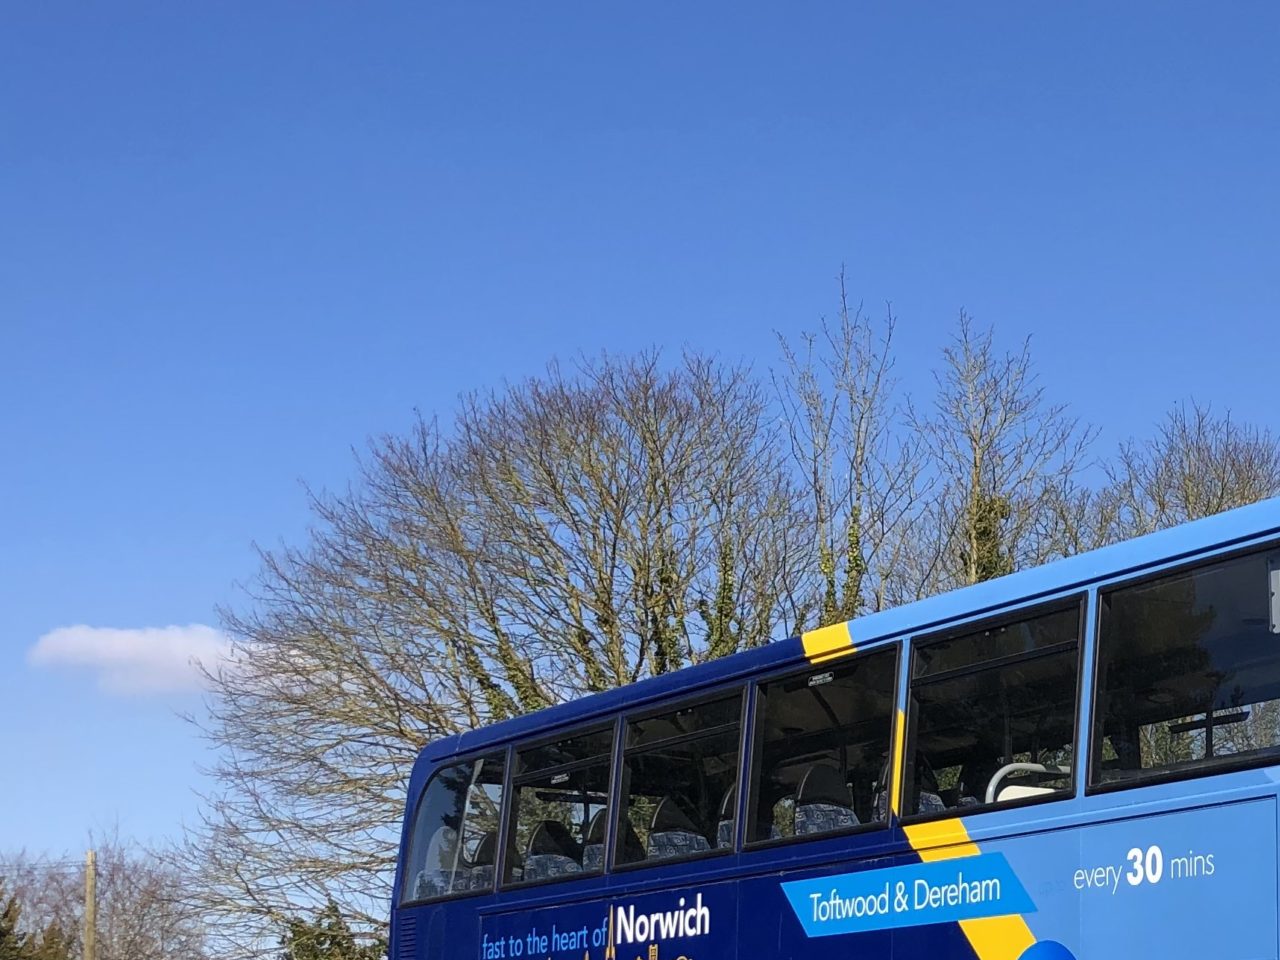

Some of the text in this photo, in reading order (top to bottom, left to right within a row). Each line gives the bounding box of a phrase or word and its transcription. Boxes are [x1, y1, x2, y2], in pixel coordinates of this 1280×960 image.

[1073, 865, 1123, 895] every
[1126, 845, 1163, 886] 30
[1171, 849, 1215, 879] mins
[810, 882, 890, 922] Toftwood
[894, 881, 909, 913] &
[913, 871, 1001, 910] Dereham
[482, 893, 711, 960] fast to the heart of Norwich
